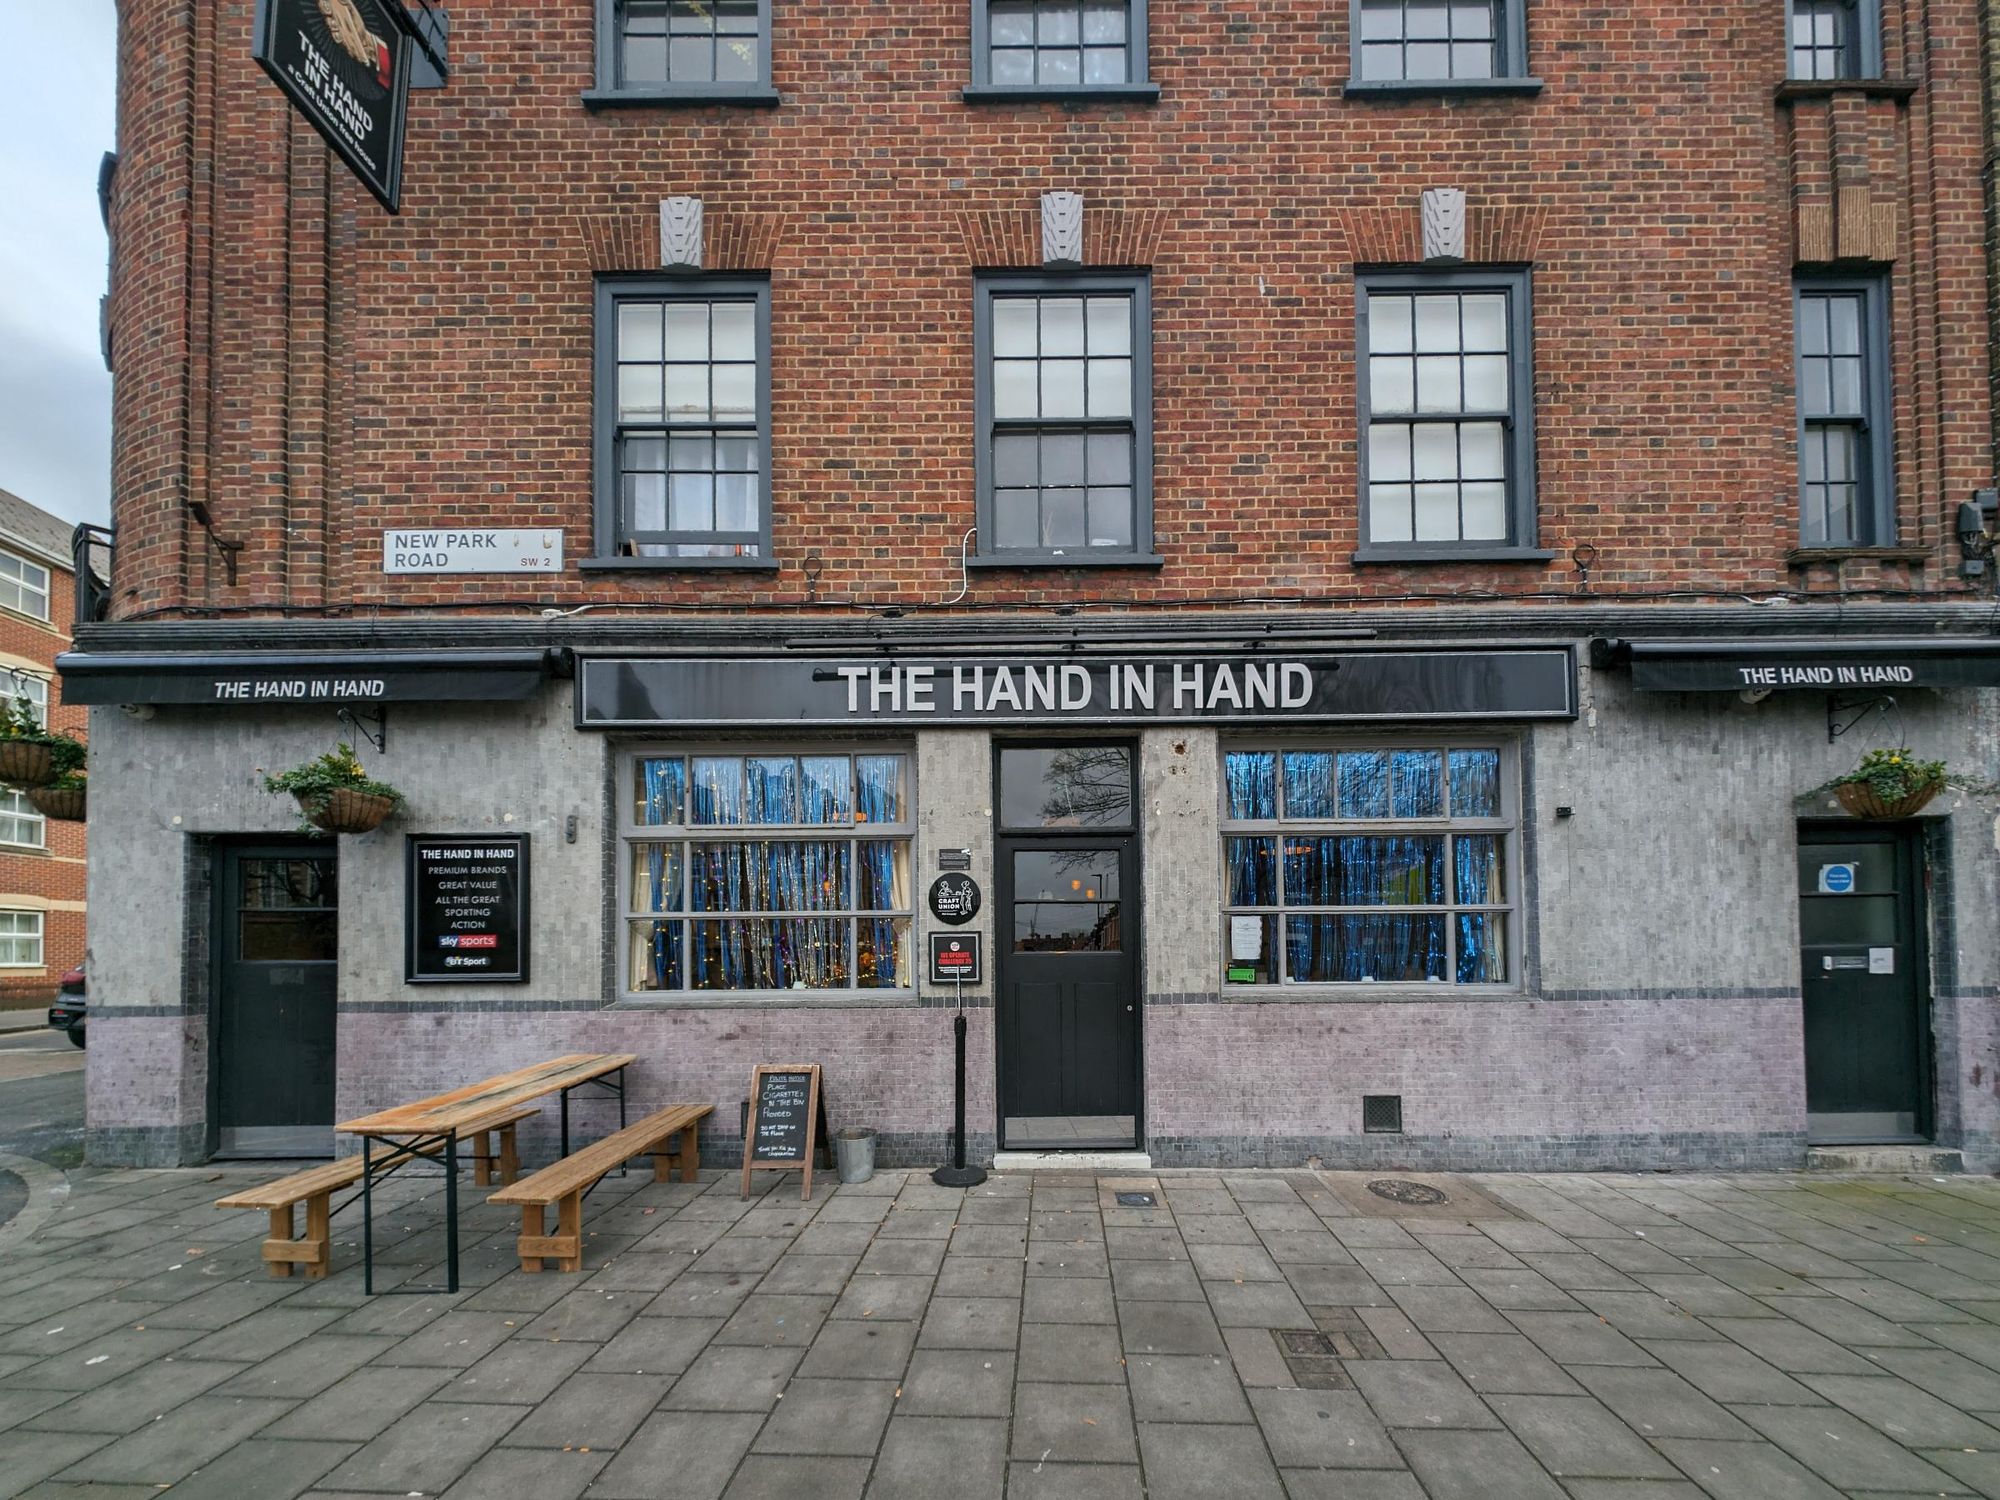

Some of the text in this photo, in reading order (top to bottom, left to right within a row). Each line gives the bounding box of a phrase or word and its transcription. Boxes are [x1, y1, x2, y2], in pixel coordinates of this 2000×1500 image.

[298, 30, 373, 132] THE HAND
[305, 60, 364, 141] IN HAND
[295, 70, 316, 100] Craft
[316, 97, 338, 128] Union
[354, 142, 376, 171] house
[395, 534, 496, 548] NEW PARK
[395, 553, 448, 567] ROAD
[521, 558, 550, 566] SW 2
[1739, 666, 1912, 684] THE HAND IN HAND
[214, 680, 384, 698] THE HAND IN HAND
[838, 663, 1313, 712] THE HAND IN HAND
[422, 849, 514, 859] THE HAND IN HAND
[428, 866, 507, 874] PREMIUM BRANDS
[438, 881, 497, 890] GREAT VALUE
[436, 896, 500, 904] ALL THE GREAT
[445, 908, 491, 917] SPORTING
[451, 921, 486, 929] ACTION
[441, 936, 494, 948] sky sports
